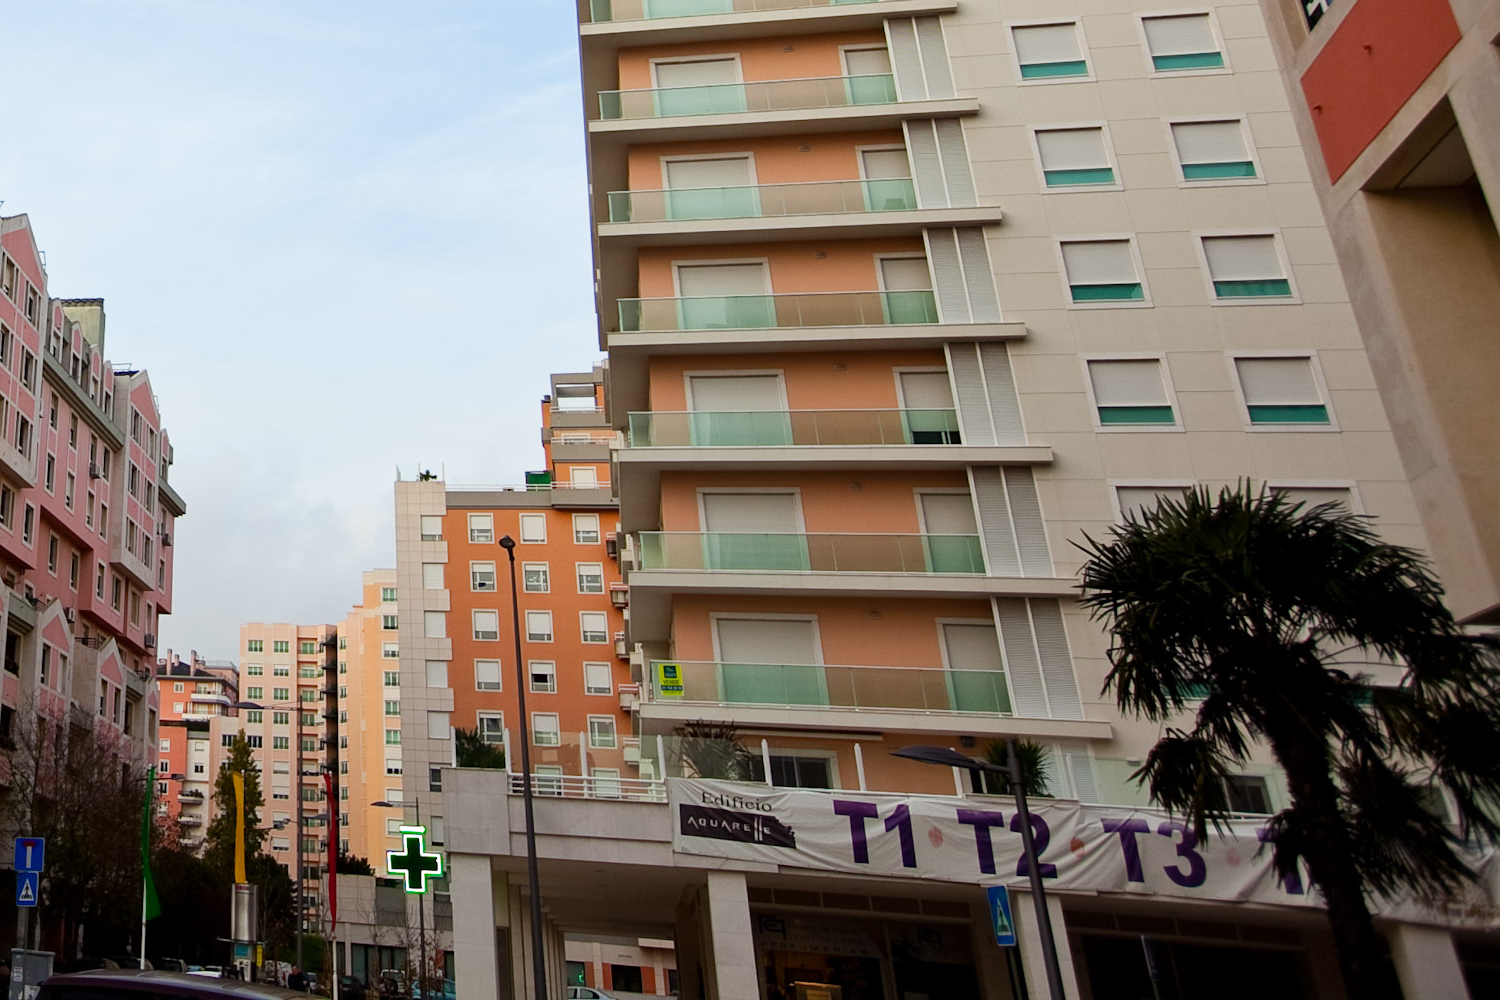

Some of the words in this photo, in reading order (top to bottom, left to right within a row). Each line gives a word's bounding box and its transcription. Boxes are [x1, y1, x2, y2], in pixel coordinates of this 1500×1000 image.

[687, 816, 772, 842] AQUARELLE
[833, 800, 917, 868] T1
[956, 809, 1058, 878] T2
[1100, 818, 1207, 888] T3
